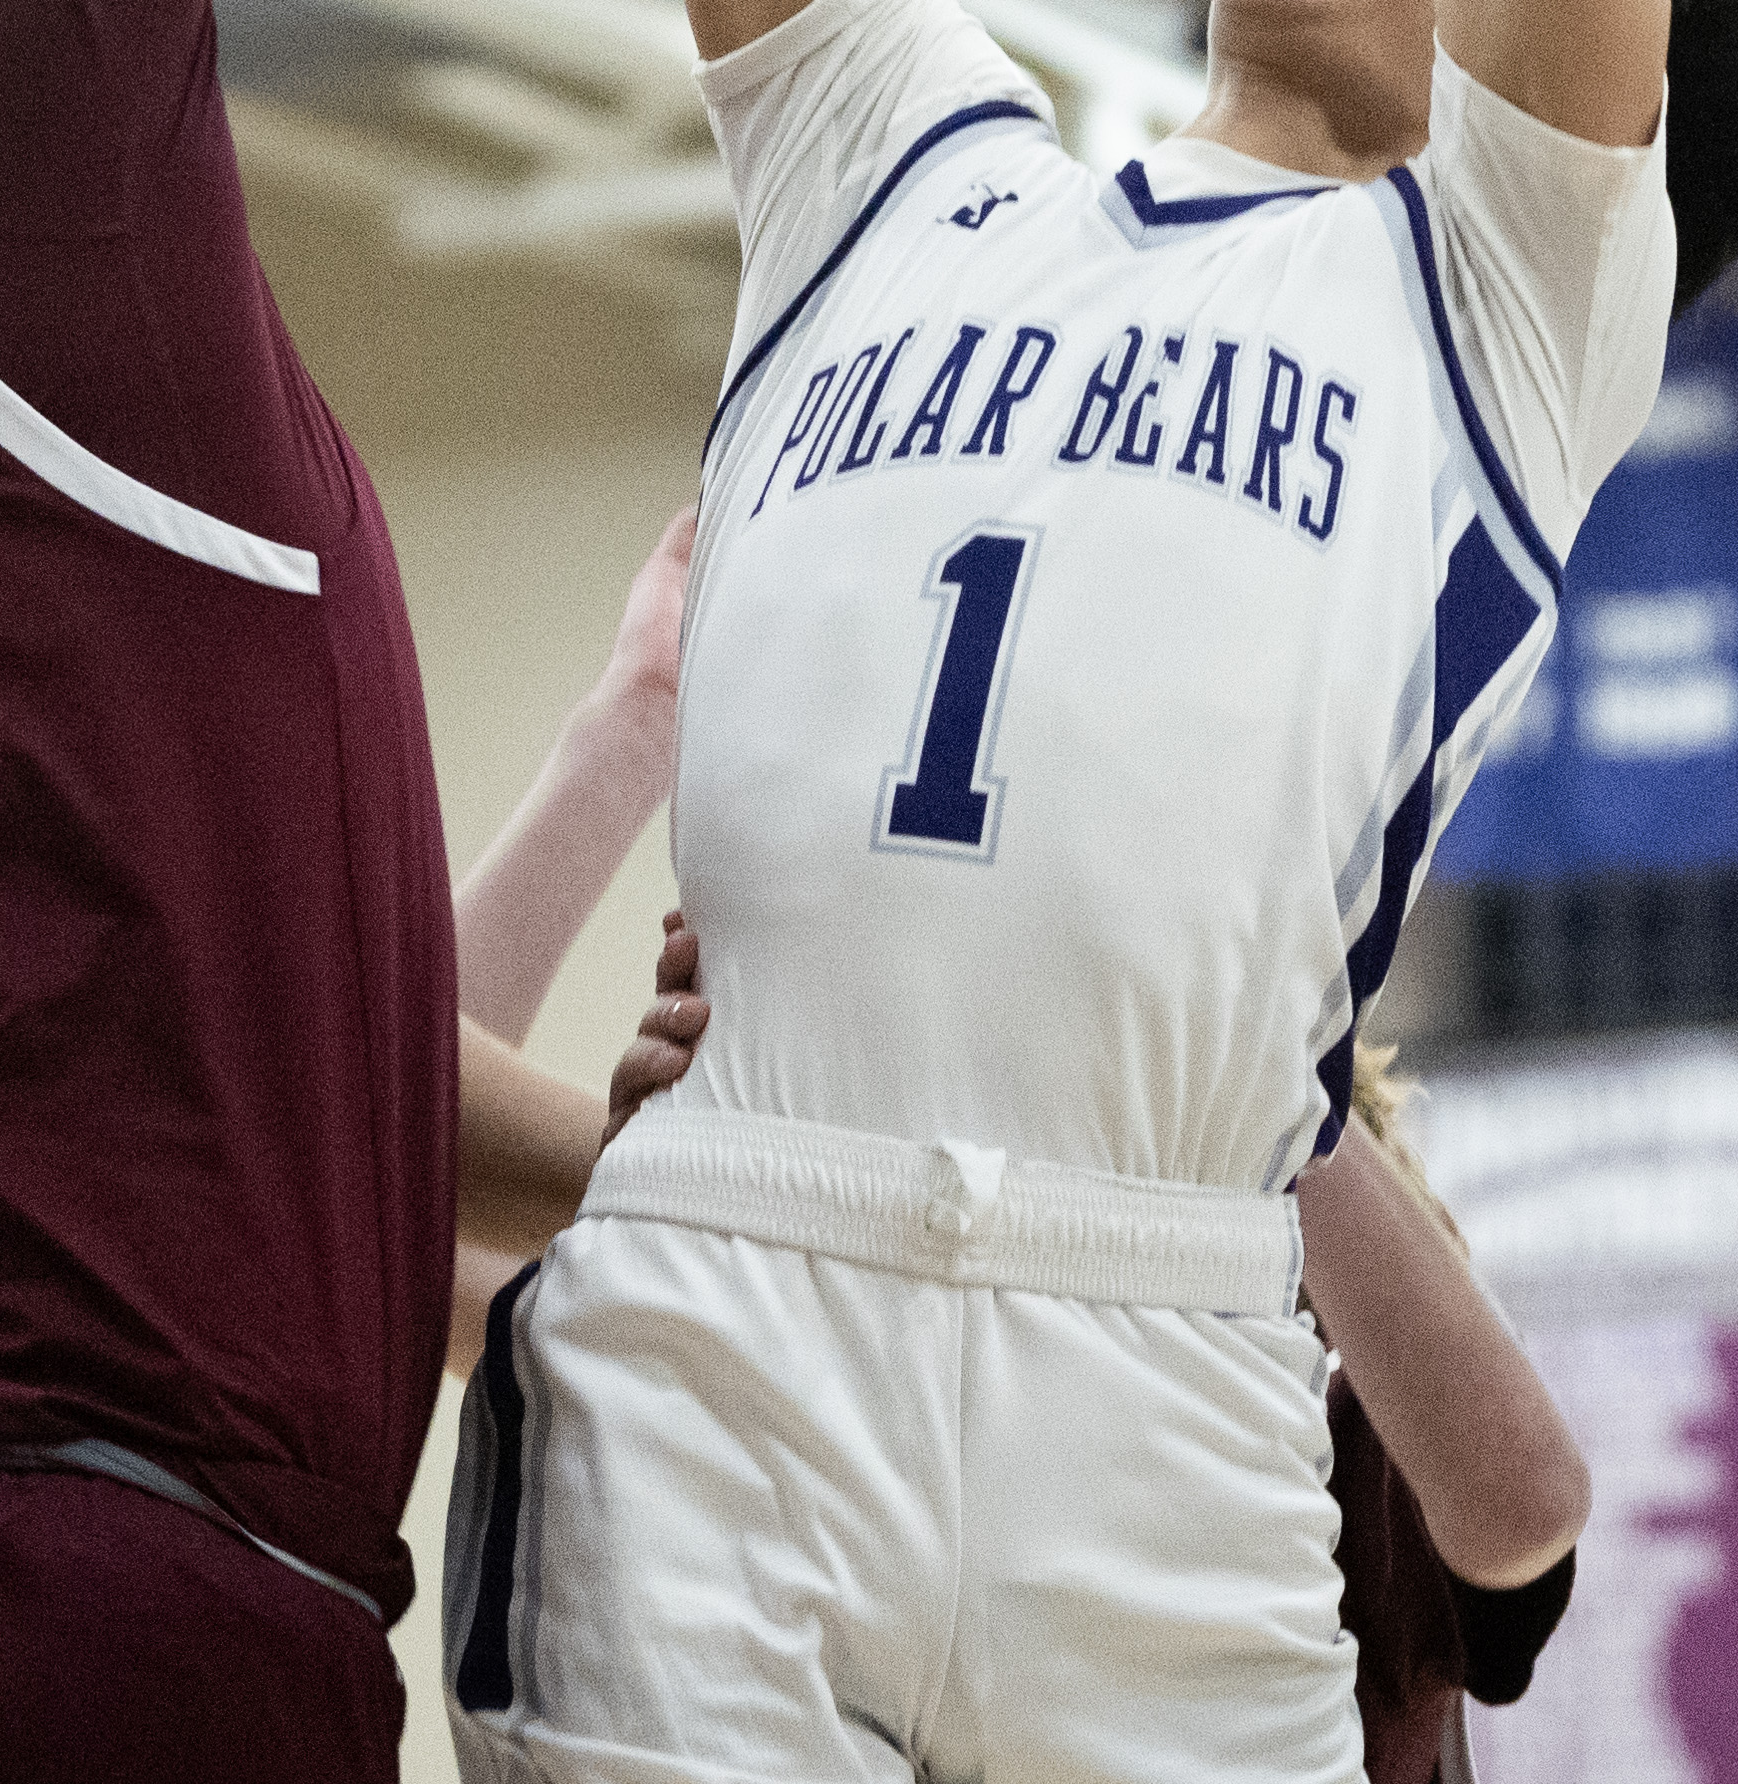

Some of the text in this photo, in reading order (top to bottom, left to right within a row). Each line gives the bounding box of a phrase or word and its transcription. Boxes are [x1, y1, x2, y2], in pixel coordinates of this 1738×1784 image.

[746, 320, 1358, 544] POLAR BEARS
[877, 526, 1040, 858] 1
